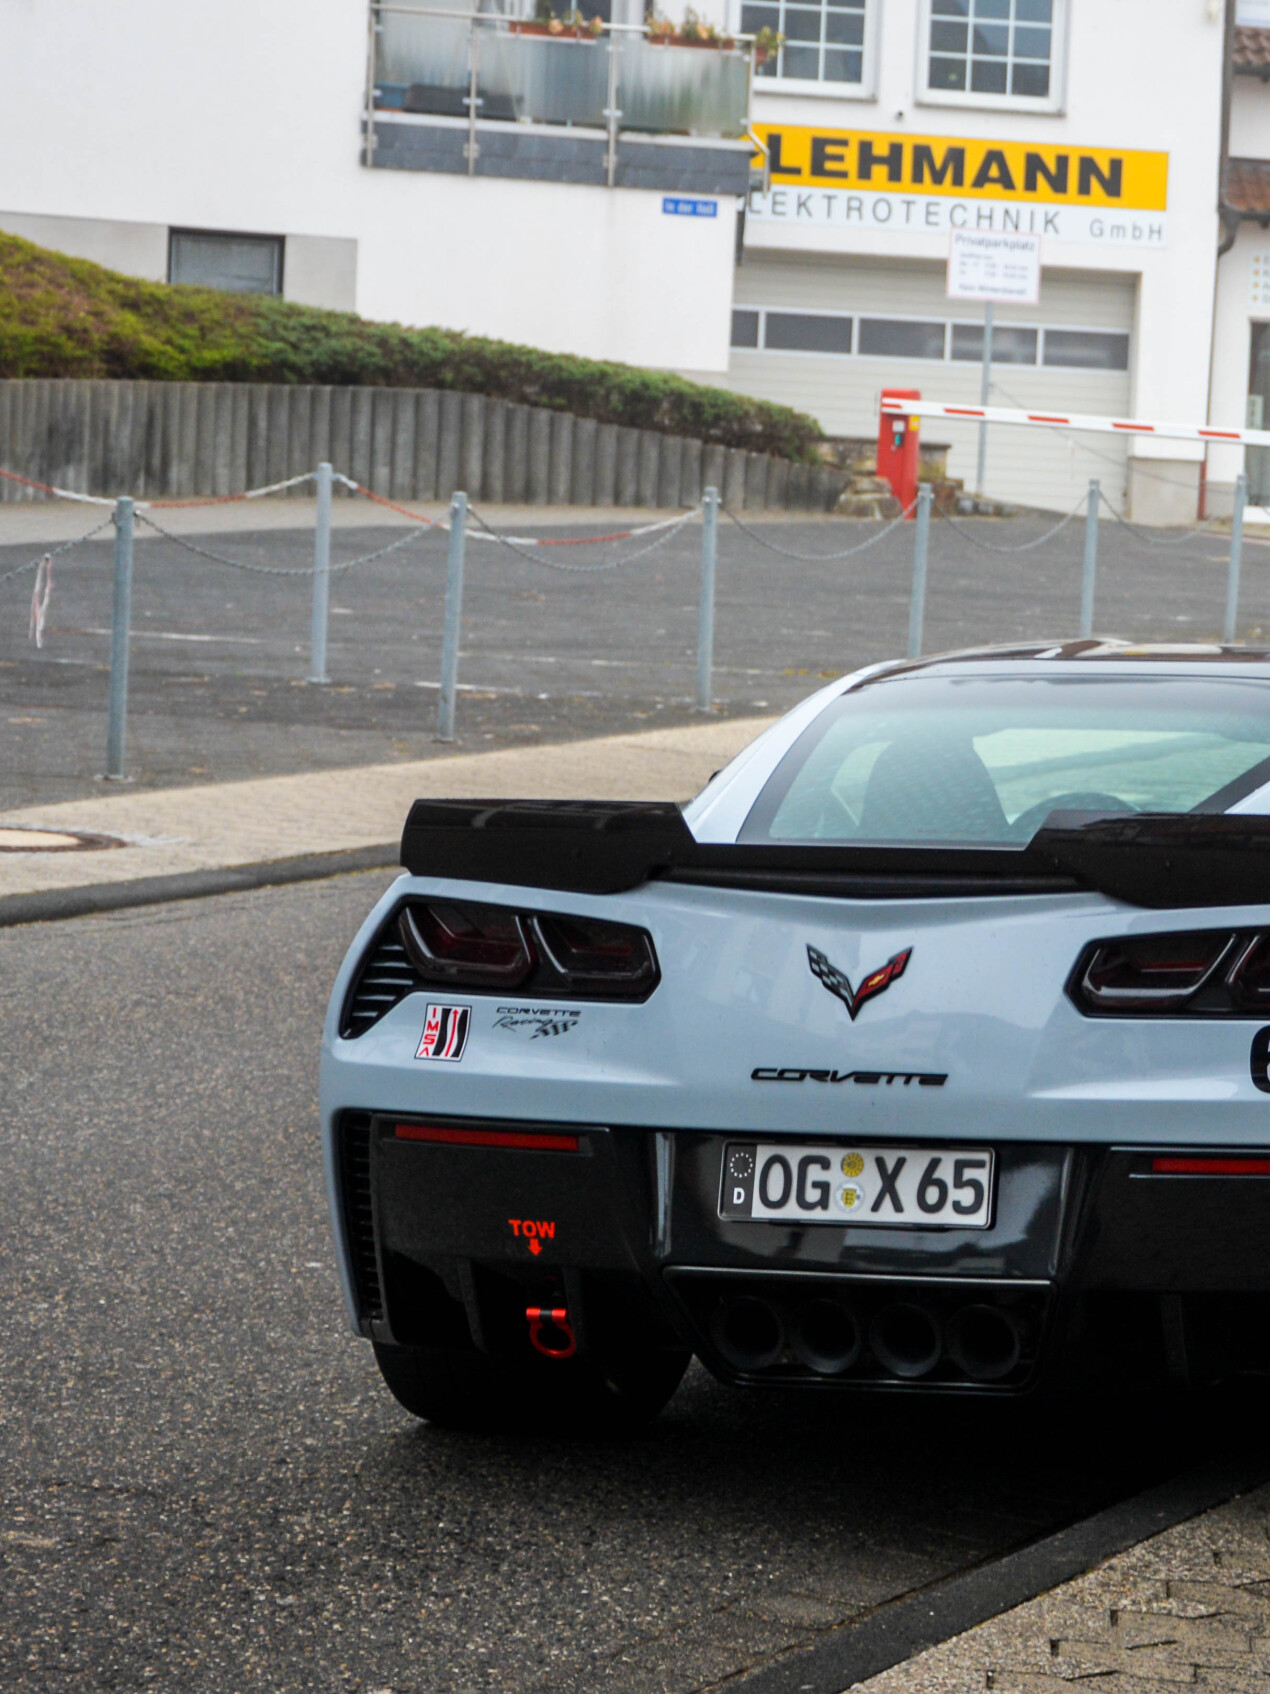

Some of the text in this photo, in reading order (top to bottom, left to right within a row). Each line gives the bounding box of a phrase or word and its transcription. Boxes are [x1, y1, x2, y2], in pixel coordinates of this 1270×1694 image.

[767, 134, 1122, 198] LEHMANN
[748, 191, 1163, 242] LEKTROTECHNIK GmbH
[953, 233, 1035, 252] Privatparkplatz
[496, 1006, 582, 1018] CORVETTE
[418, 1006, 440, 1058] IMSA
[750, 1067, 949, 1086] CORVETTE
[758, 1153, 831, 1211] OG
[732, 1187, 746, 1204] D
[508, 1219, 556, 1238] TOW
